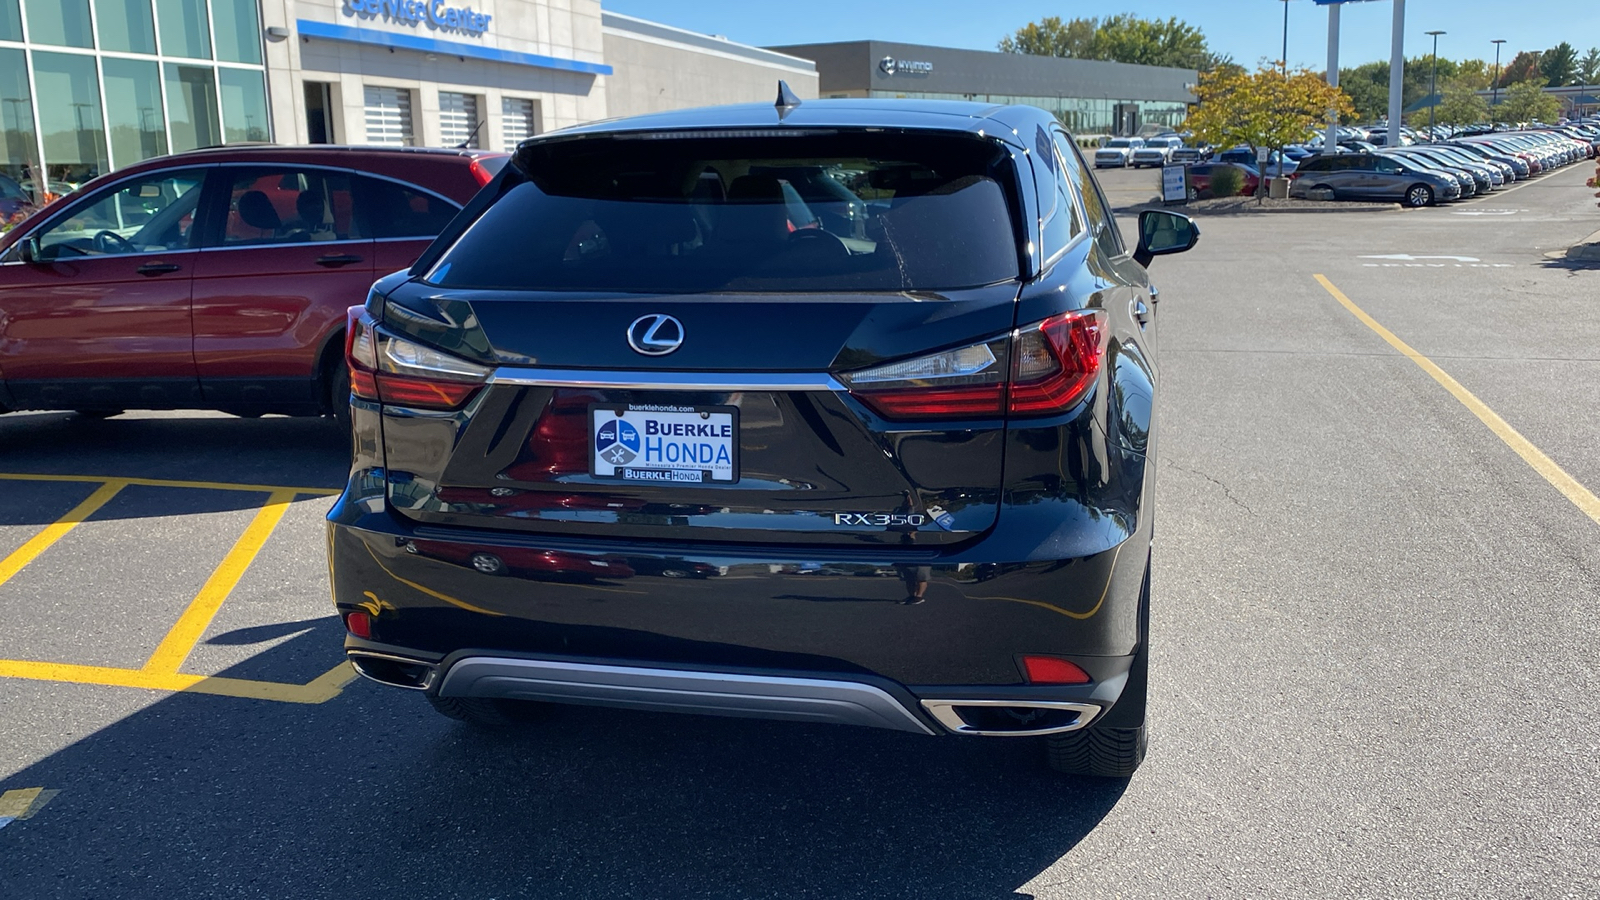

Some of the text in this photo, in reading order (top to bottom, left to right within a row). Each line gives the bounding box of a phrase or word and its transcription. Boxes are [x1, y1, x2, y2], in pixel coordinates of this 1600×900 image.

[431, 0, 492, 32] Center
[628, 403, 695, 413] buerklehonda.com
[645, 419, 731, 438] BUERKLE
[645, 436, 731, 465] HONDA
[625, 469, 701, 481] BUERKLE HONDA
